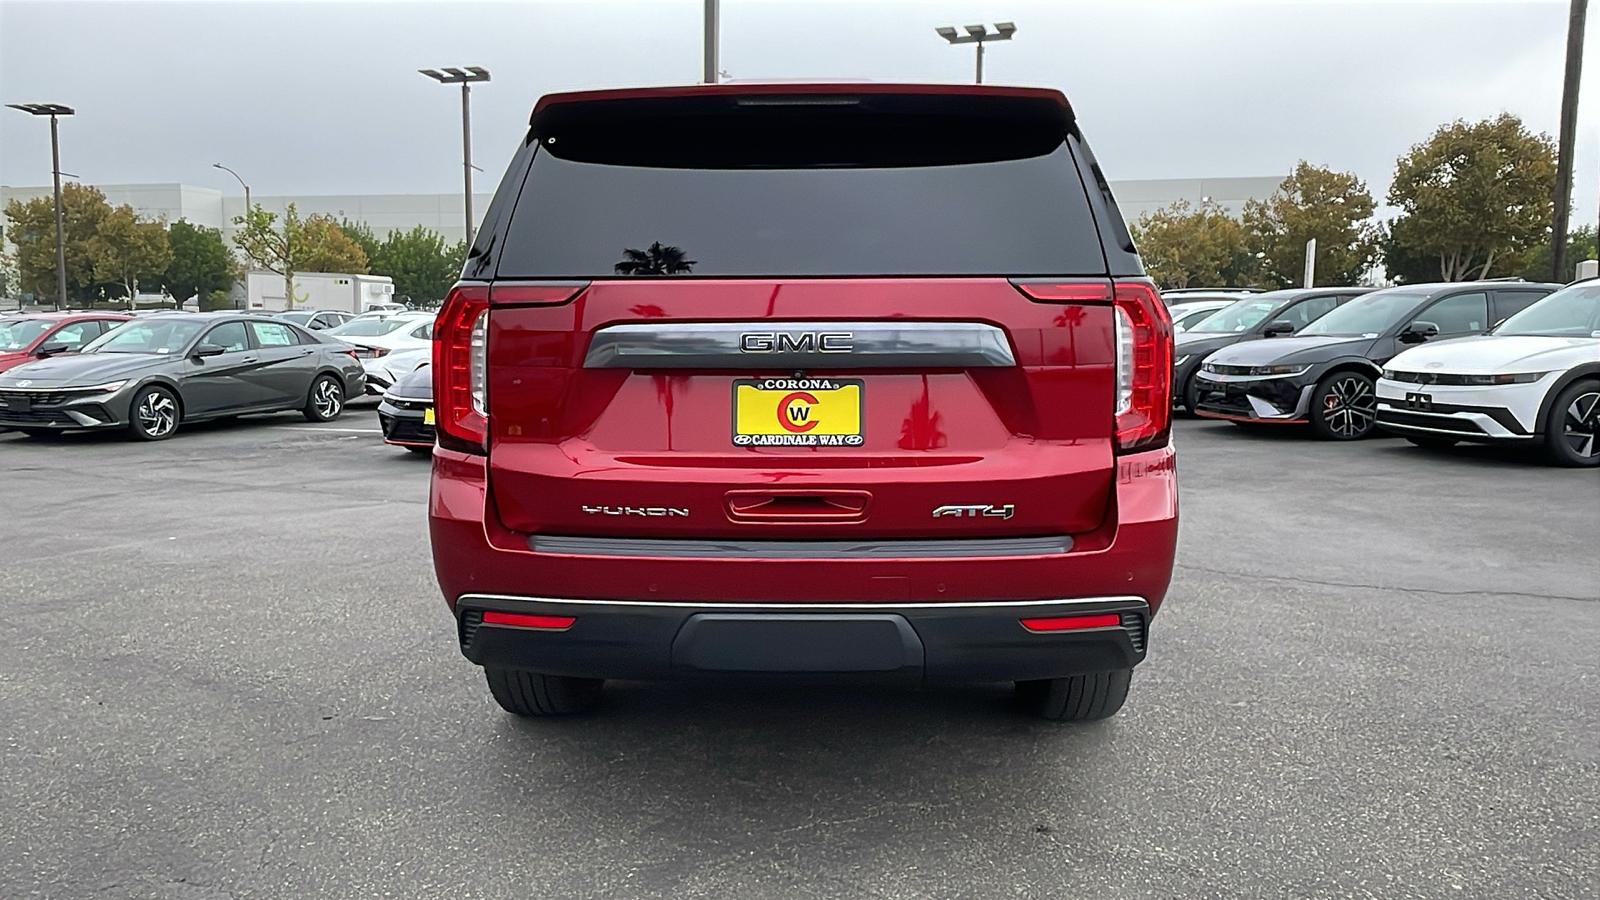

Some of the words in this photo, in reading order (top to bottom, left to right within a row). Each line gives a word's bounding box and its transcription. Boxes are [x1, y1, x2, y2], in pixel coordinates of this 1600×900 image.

[739, 332, 853, 353] GMC
[764, 379, 832, 389] CORONA
[789, 407, 810, 421] W
[752, 435, 817, 445] CARDINALE
[819, 435, 845, 445] WAY
[582, 505, 689, 517] YUKON
[932, 504, 1015, 520] AT4
